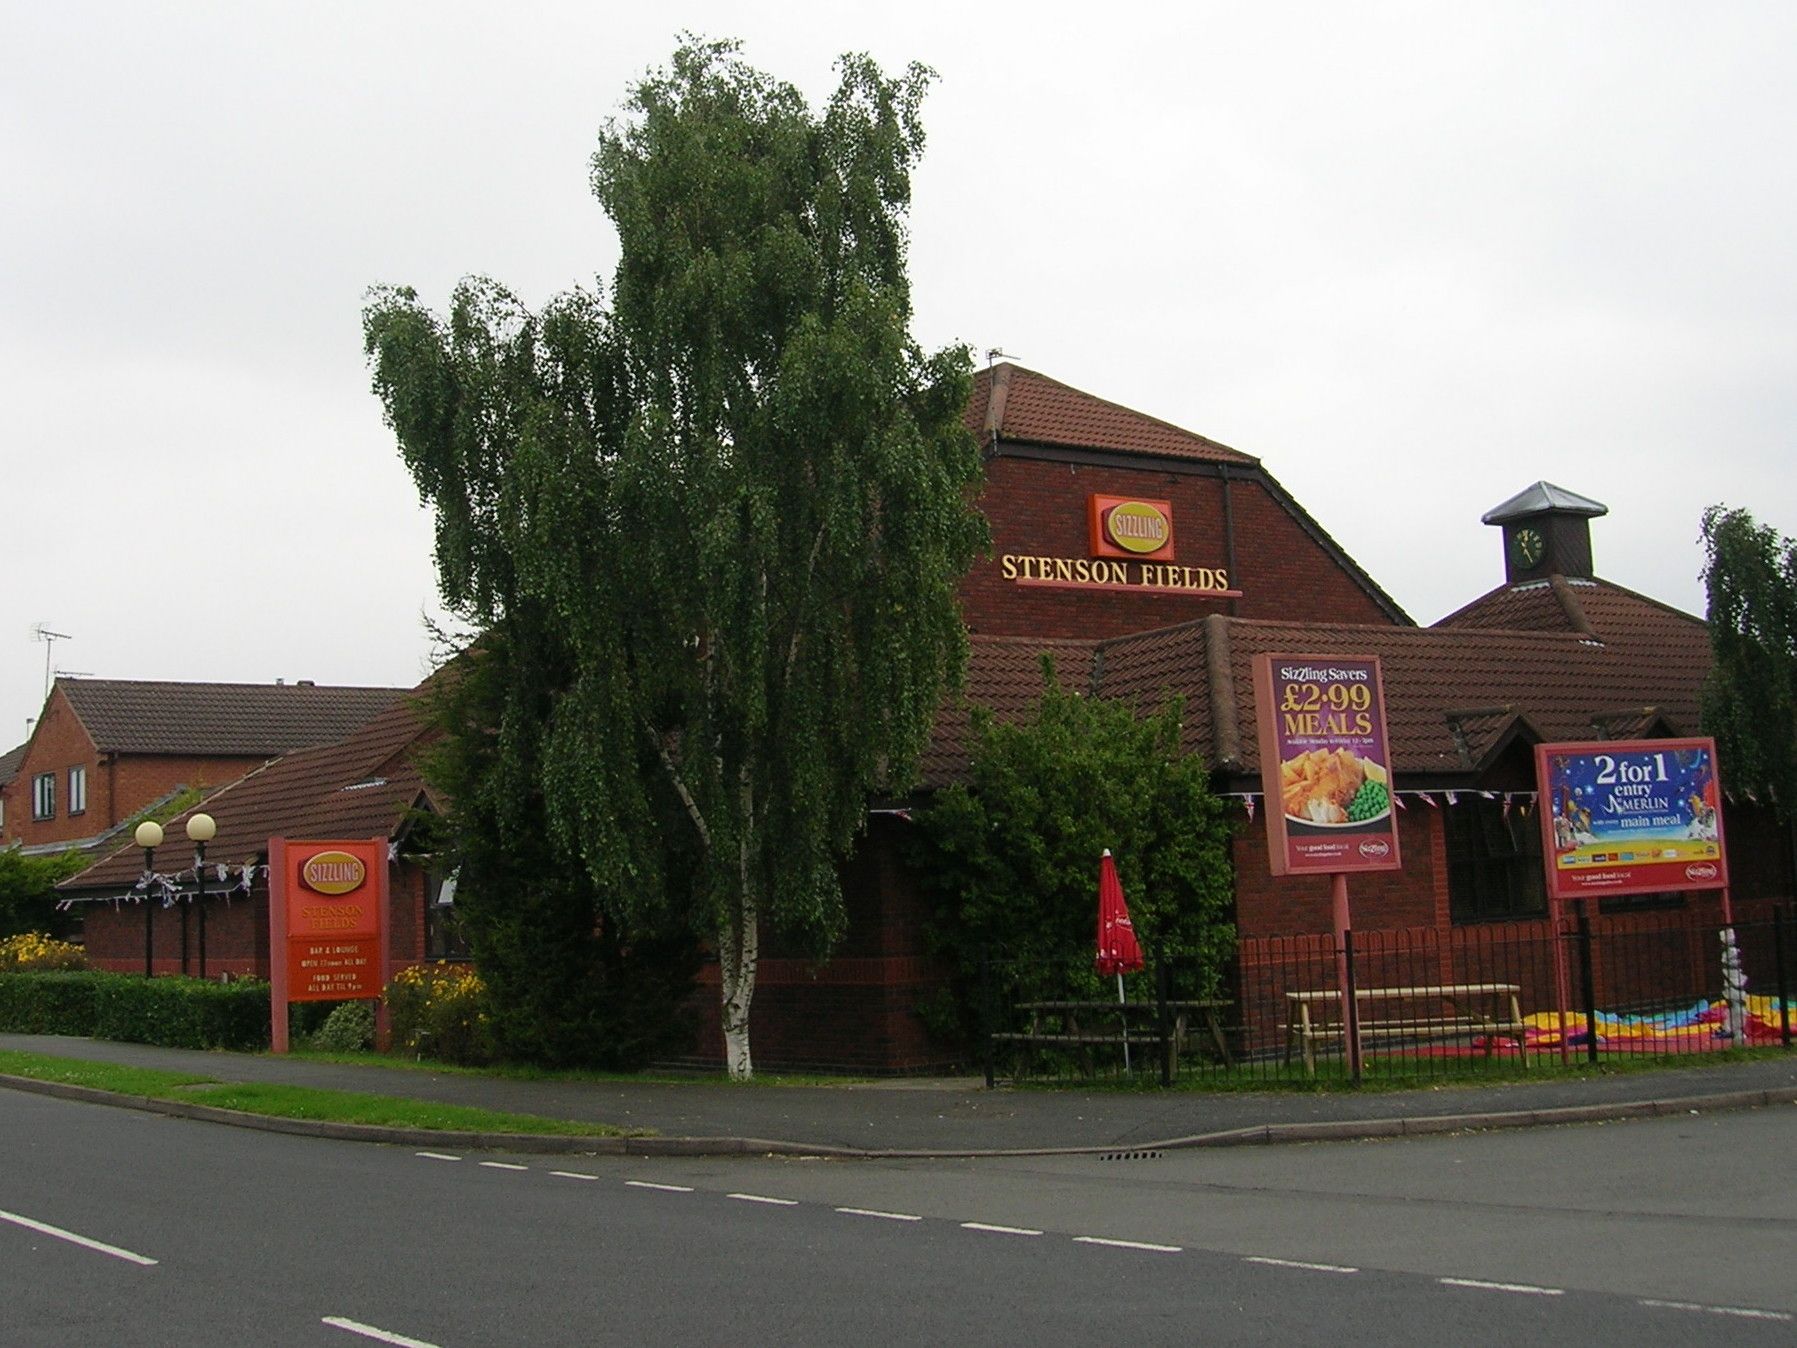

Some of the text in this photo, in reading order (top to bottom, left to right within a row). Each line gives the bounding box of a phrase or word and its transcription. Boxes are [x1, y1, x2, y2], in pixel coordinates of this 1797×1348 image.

[1116, 514, 1163, 539] SIZZLING
[1002, 554, 1229, 591] STENSON FIELDS
[1328, 668, 1367, 681] Savers
[1285, 713, 1373, 736] MEALS
[1595, 754, 1670, 784] 2 for 1
[1614, 784, 1652, 798] entry
[1623, 797, 1669, 810] MERLIN
[1621, 816, 1650, 828] main
[1652, 814, 1681, 825] meal
[310, 863, 359, 882] SIZZLING
[302, 905, 364, 919] STENSON
[311, 917, 359, 930] FIELDS
